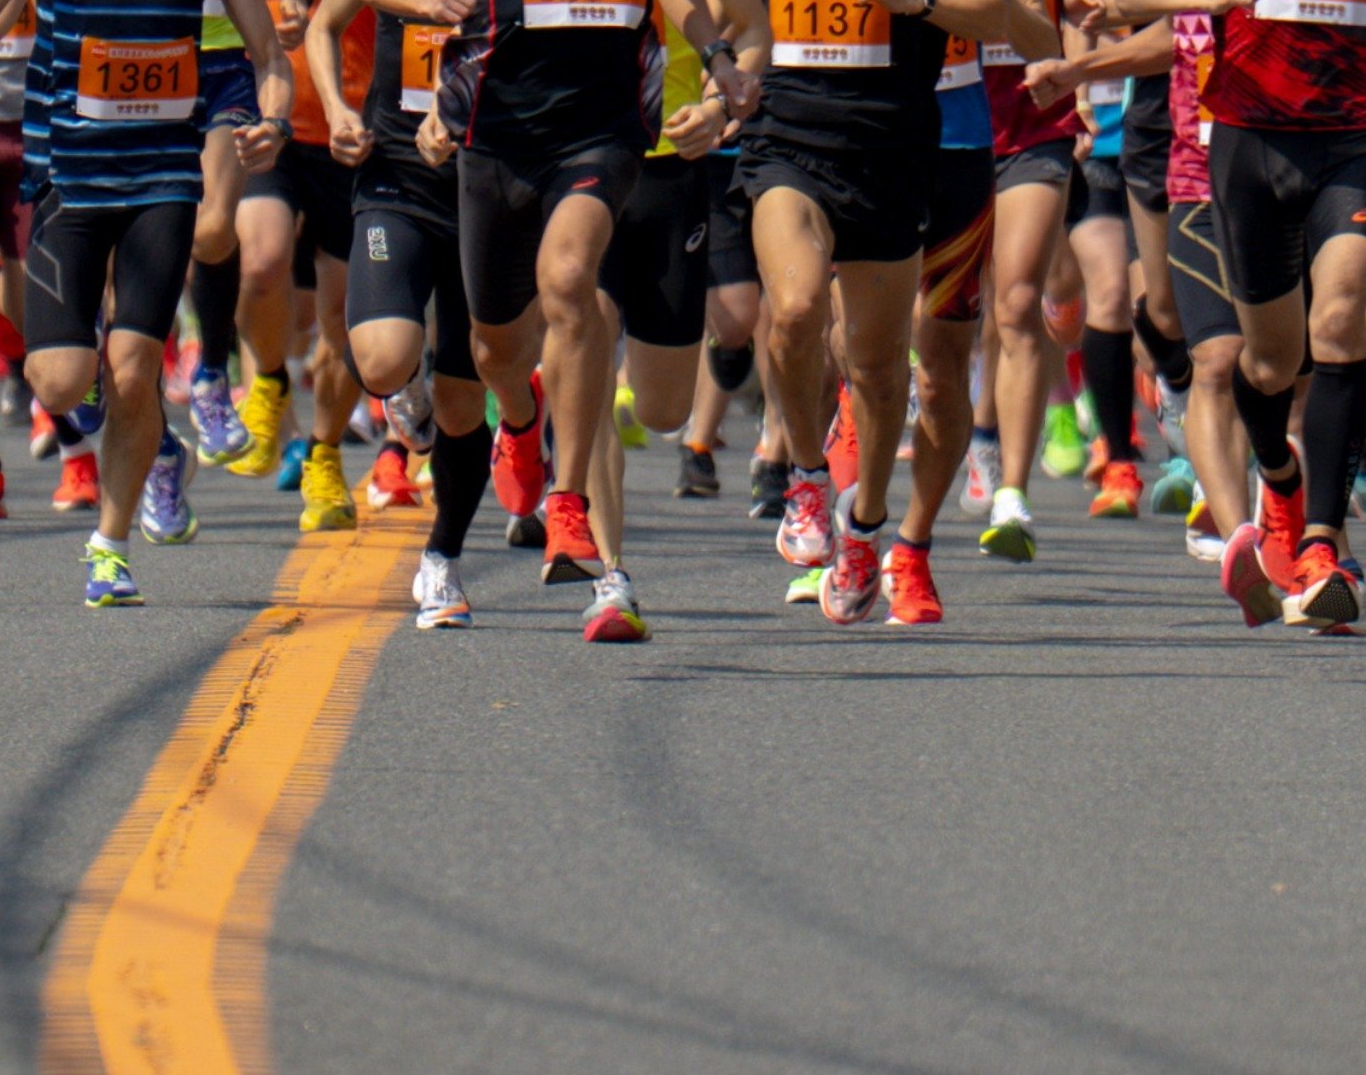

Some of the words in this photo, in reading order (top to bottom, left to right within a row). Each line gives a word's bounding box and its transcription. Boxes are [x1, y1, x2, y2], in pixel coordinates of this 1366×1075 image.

[783, 2, 873, 38] 1137
[97, 61, 180, 93] 1361
[367, 227, 389, 261] 2XU
